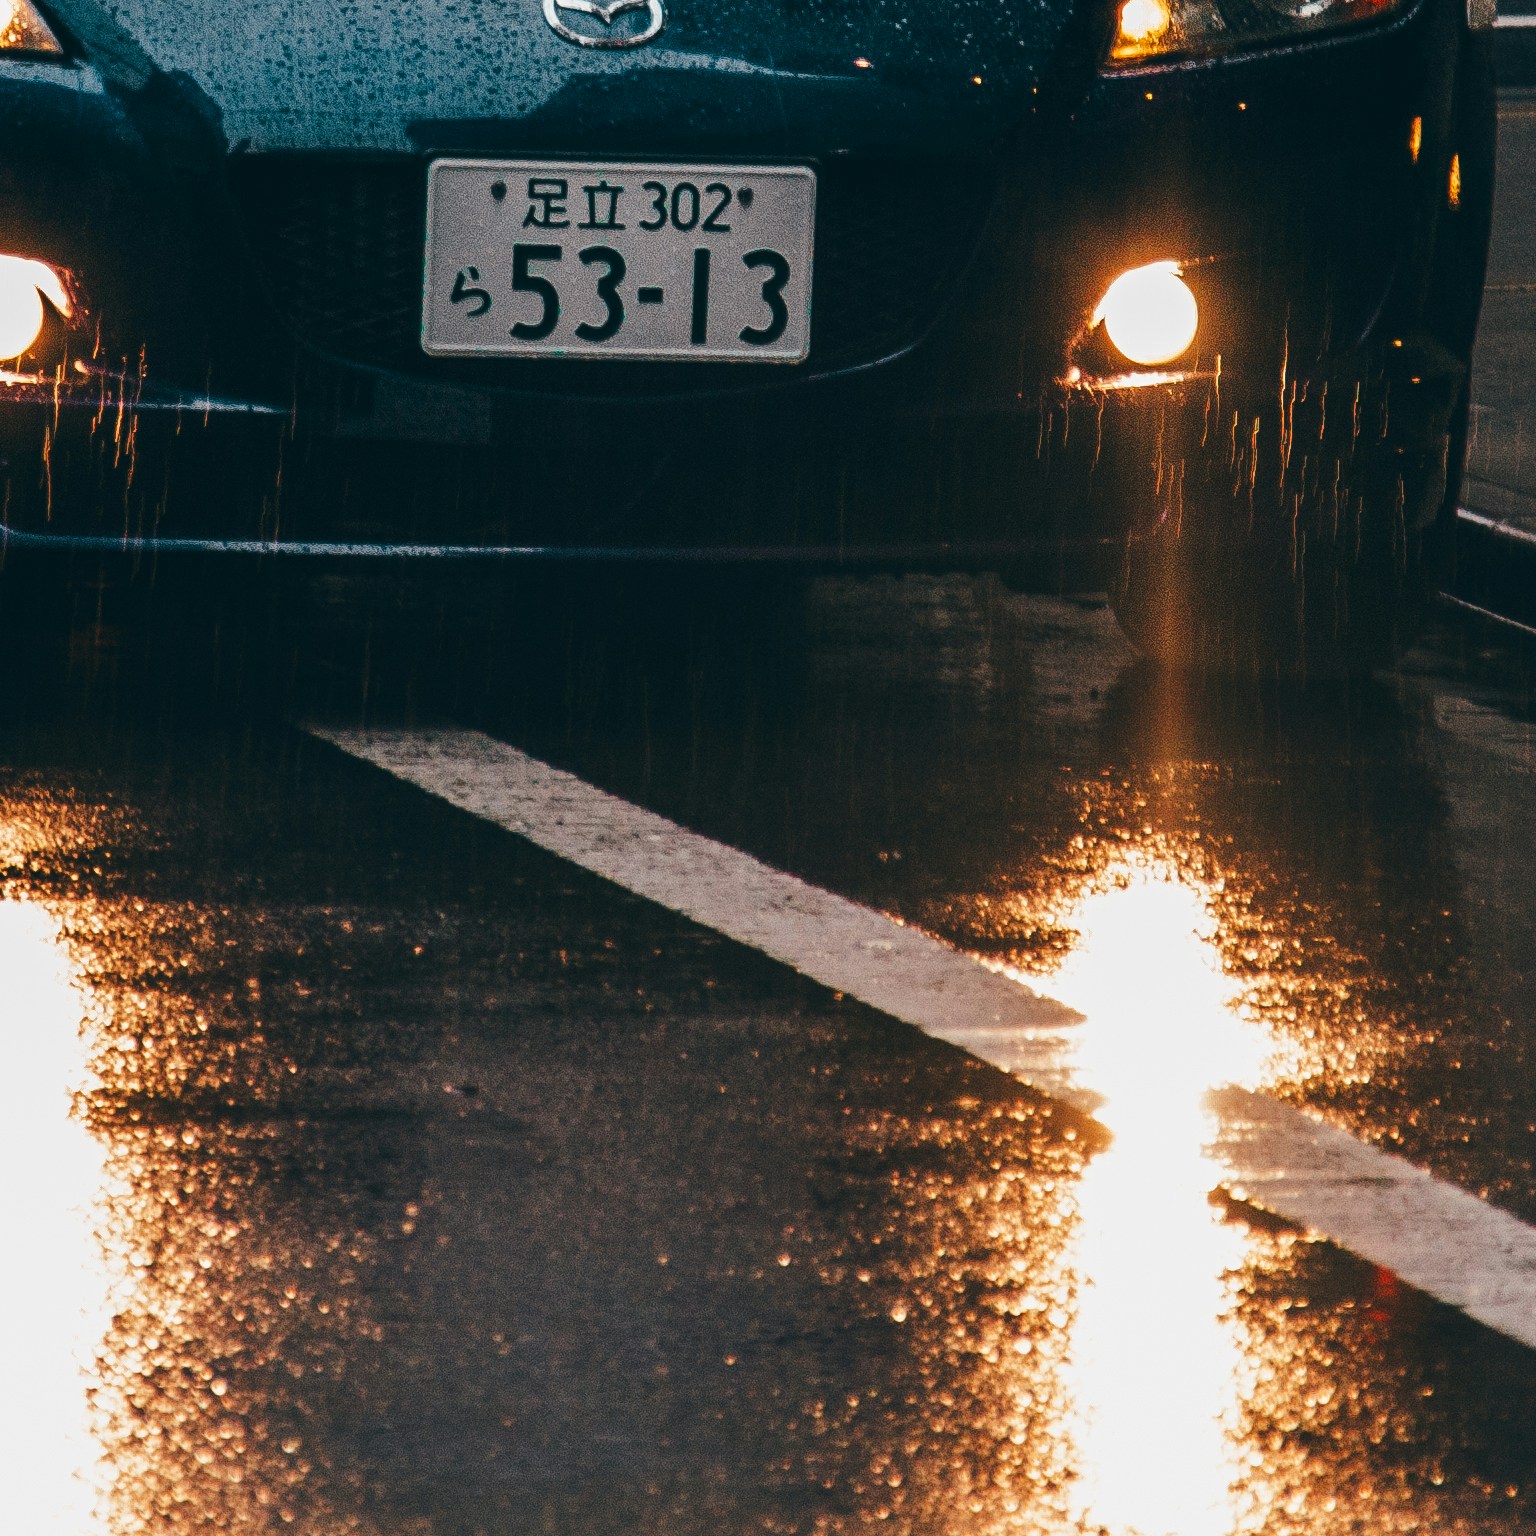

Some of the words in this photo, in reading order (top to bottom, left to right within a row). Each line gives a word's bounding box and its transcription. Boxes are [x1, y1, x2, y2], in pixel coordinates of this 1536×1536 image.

[522, 178, 626, 230] 足立
[638, 180, 733, 233] 302
[450, 266, 492, 318] ら
[509, 244, 791, 346] 53-13
